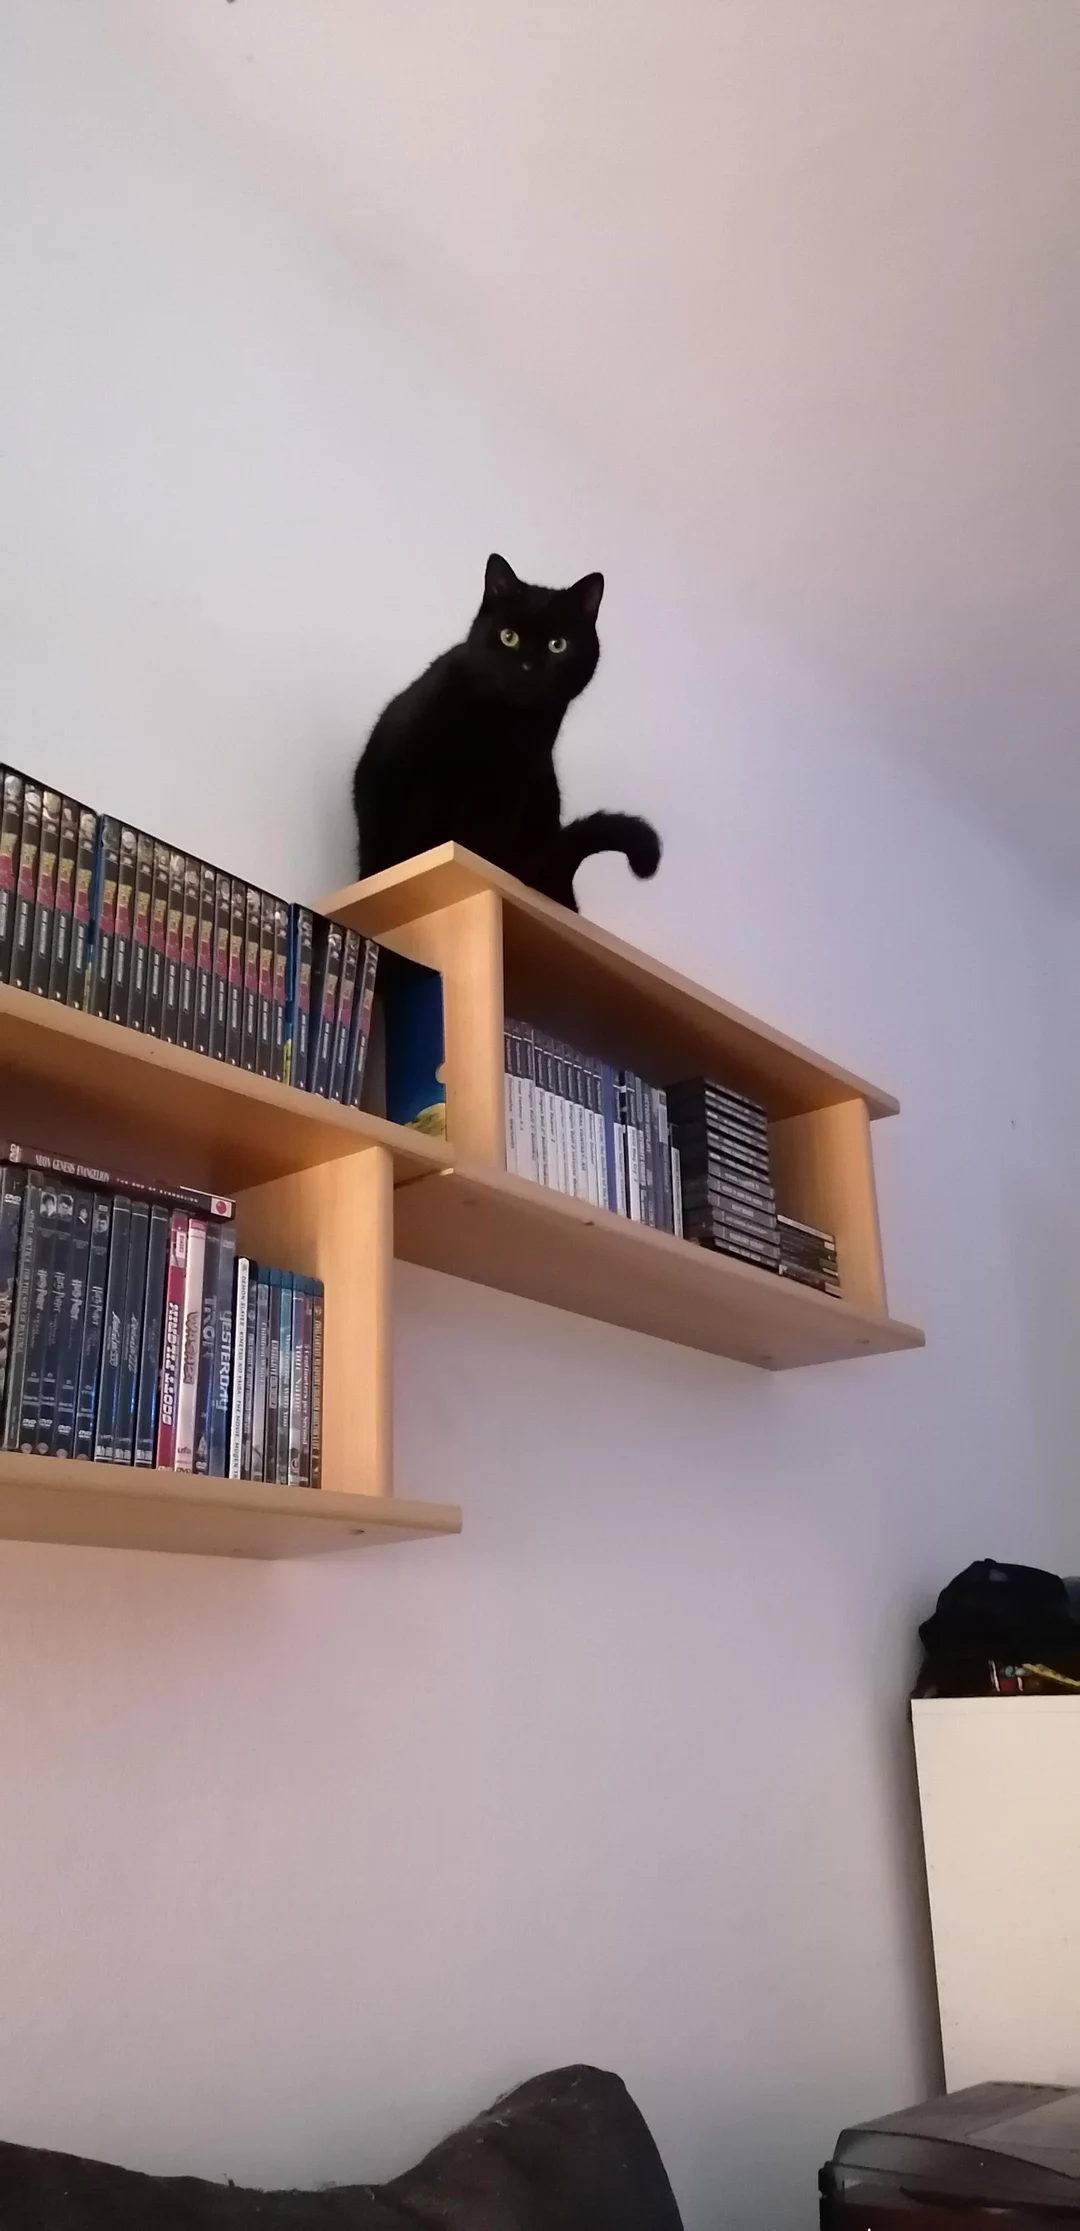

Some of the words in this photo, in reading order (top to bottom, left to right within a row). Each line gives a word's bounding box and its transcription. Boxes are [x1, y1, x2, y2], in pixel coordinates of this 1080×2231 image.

[36, 1154, 51, 1168] NEON
[52, 1159, 76, 1175] GENESIS
[76, 1165, 110, 1183] EVANGELION
[166, 1302, 179, 1371] PILGRIM
[216, 1310, 232, 1411] YESTERDAY
[163, 1372, 175, 1426] SCOTT
